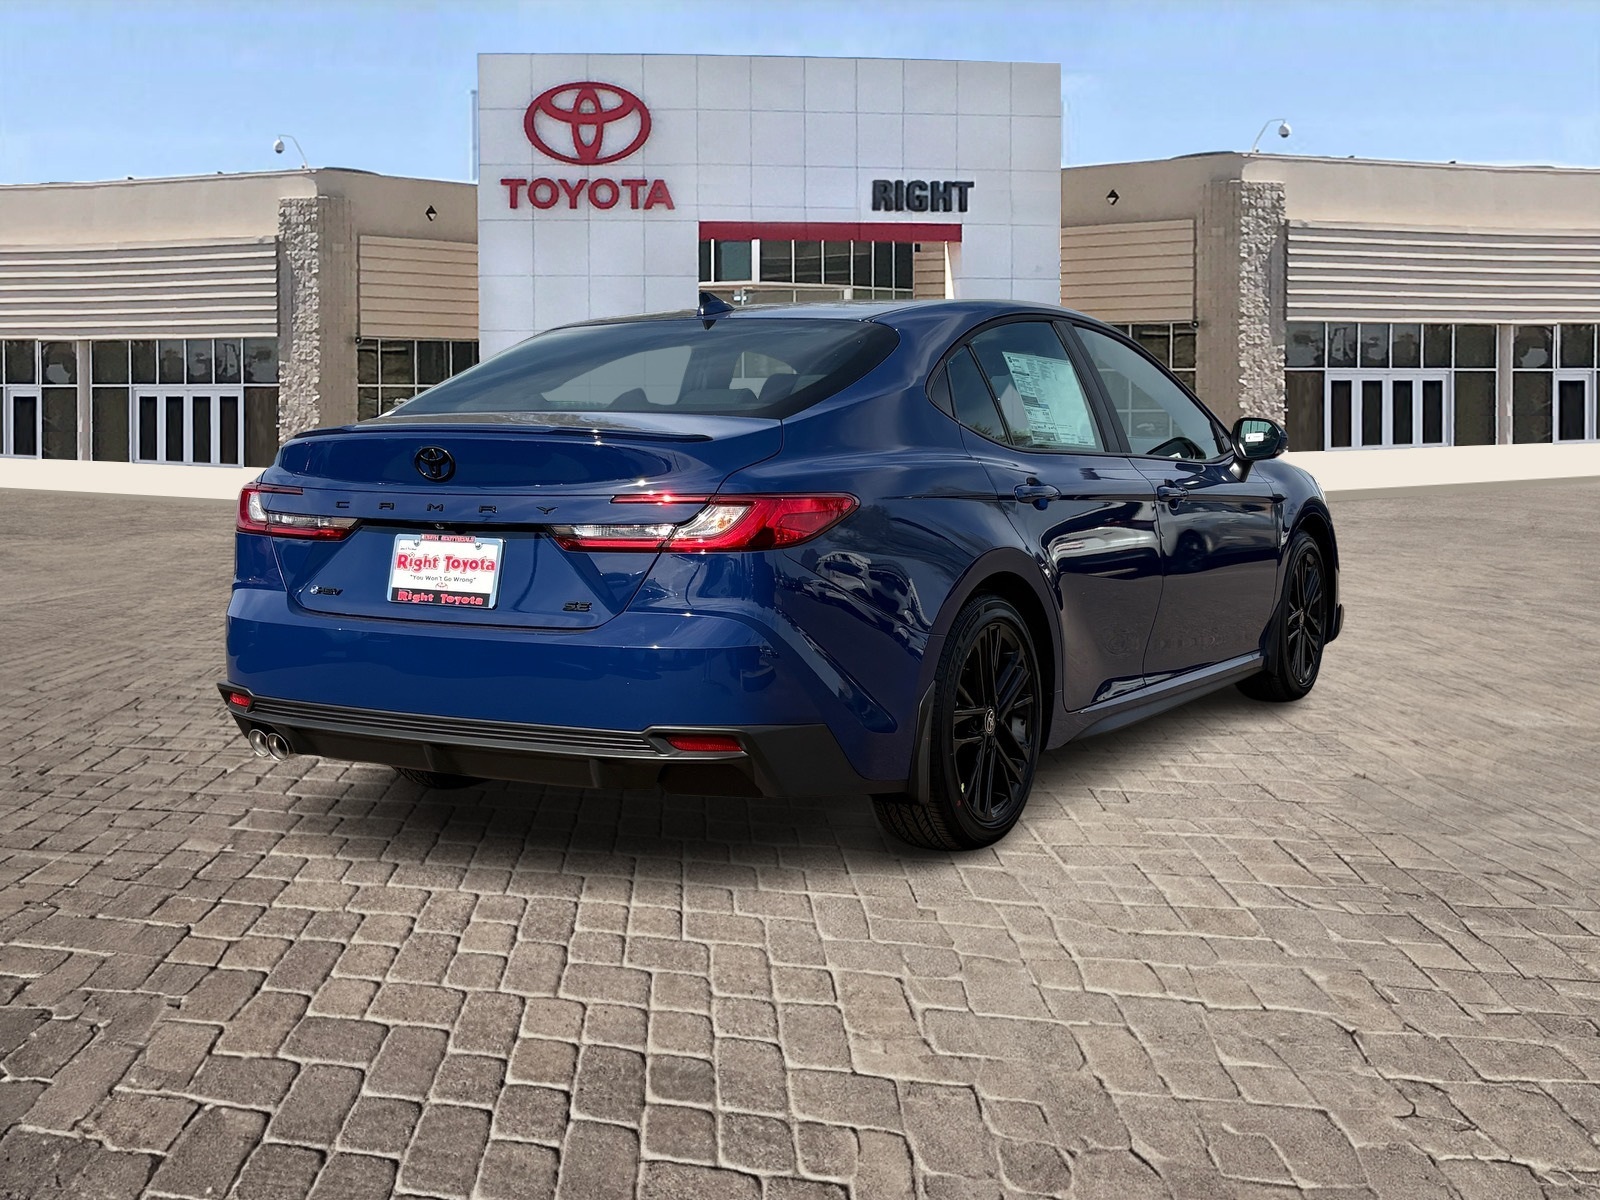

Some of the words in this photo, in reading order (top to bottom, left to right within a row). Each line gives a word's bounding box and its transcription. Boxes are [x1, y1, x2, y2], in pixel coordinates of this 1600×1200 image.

[500, 178, 675, 210] TOYOTA
[871, 179, 975, 212] RIGHT
[335, 500, 558, 515] CAMRY
[396, 553, 440, 573] Right
[444, 554, 496, 574] Toyota
[397, 590, 434, 604] Right
[440, 593, 484, 606] Toyota
[562, 601, 592, 613] SE
